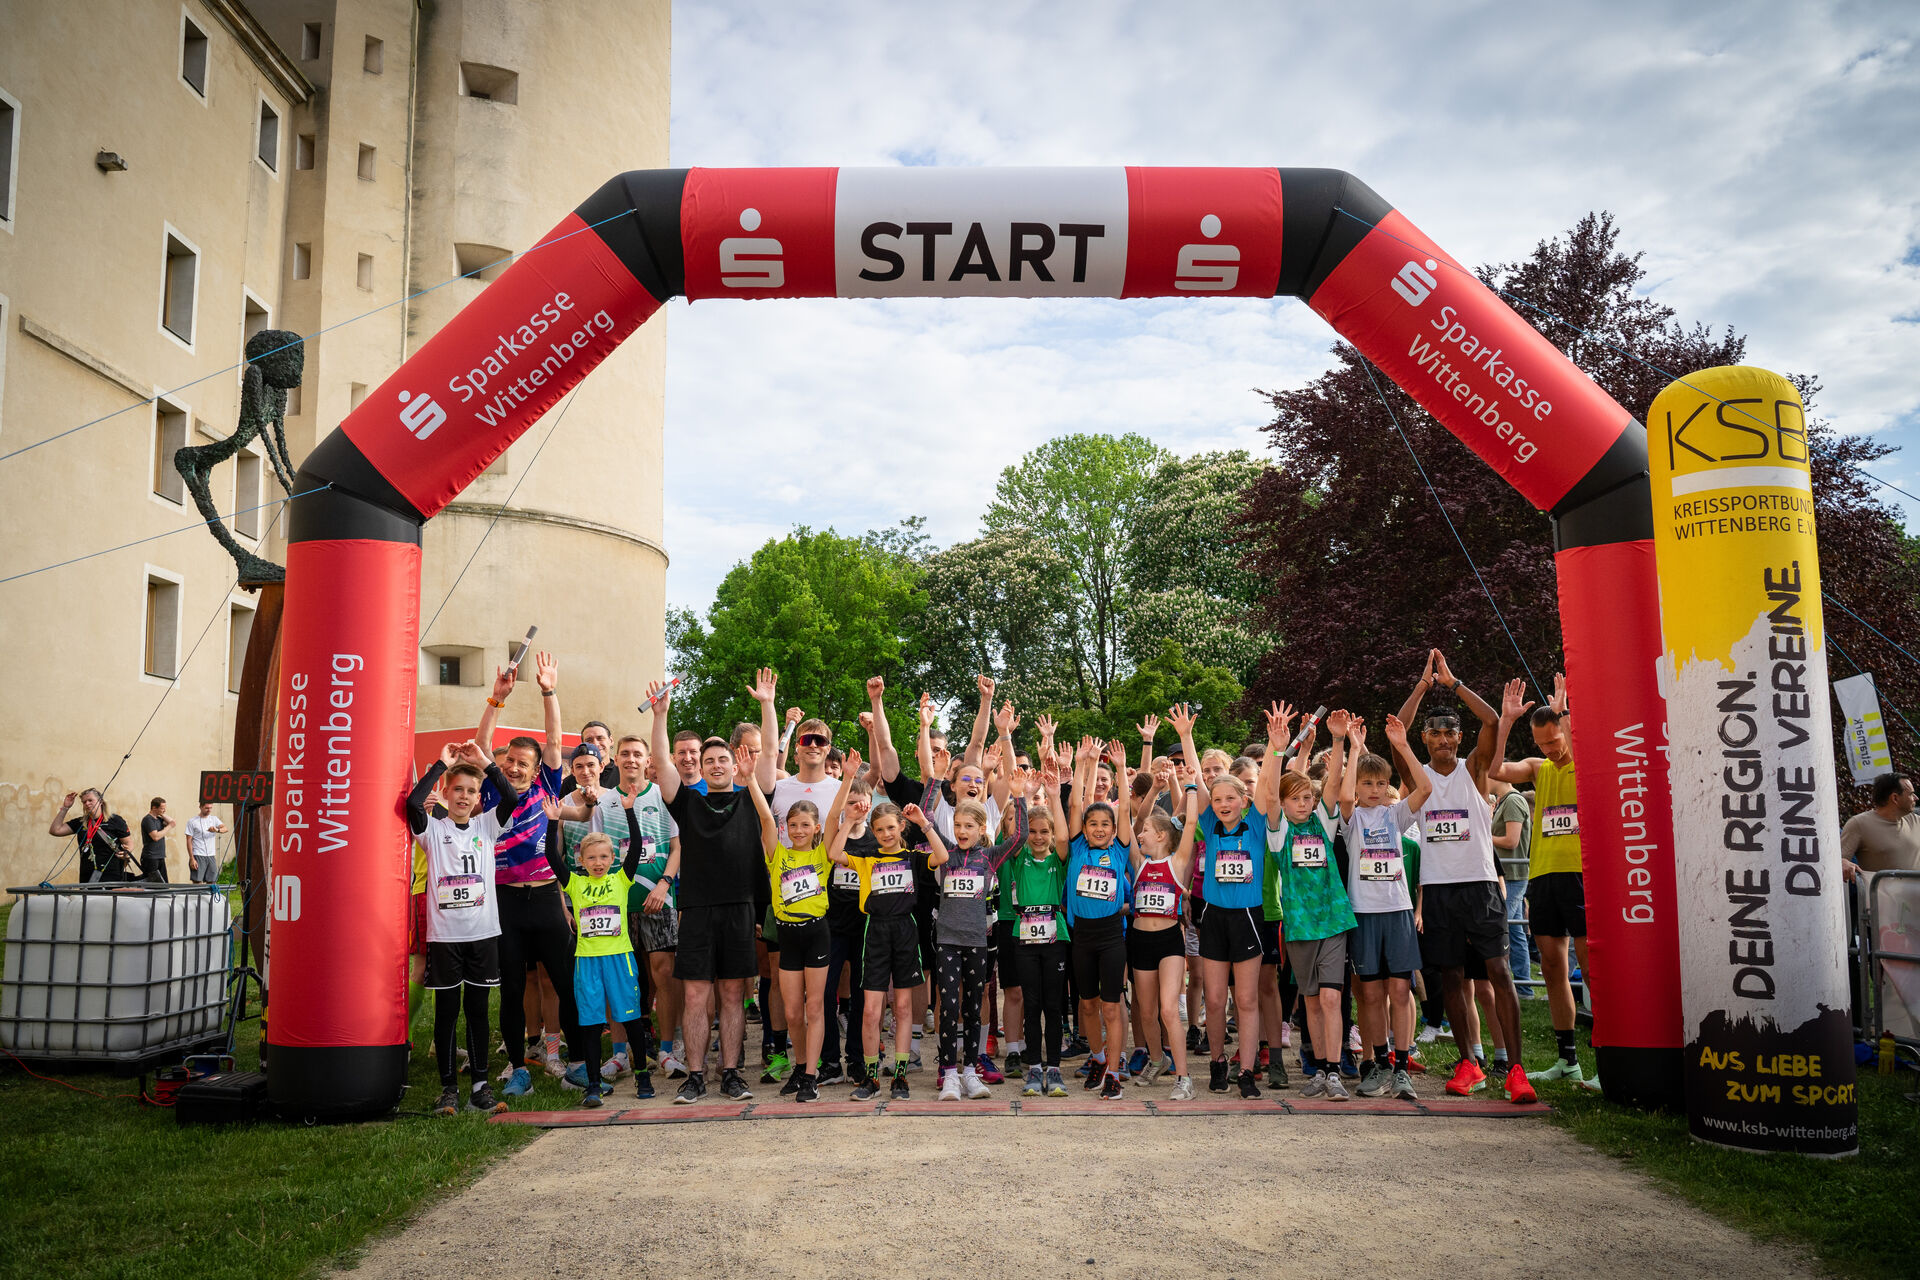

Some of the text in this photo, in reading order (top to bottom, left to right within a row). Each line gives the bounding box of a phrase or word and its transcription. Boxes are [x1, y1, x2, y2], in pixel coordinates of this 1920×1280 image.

[858, 222, 1105, 282] START
[448, 292, 575, 403] Sparkasse
[474, 309, 615, 427] Wittenberg
[1430, 305, 1552, 421] Sparkasse
[1407, 333, 1538, 464] Wittenberg
[1666, 398, 1807, 471] KSB
[1673, 494, 1813, 520] KREISSPORTBUND
[1675, 516, 1791, 541] WITTENBERG
[1764, 560, 1821, 896] DEINE VEREINE.
[280, 672, 309, 853] Sparkasse
[317, 653, 363, 854] Wittenberg
[1435, 821, 1457, 834] 431
[1550, 816, 1571, 829] 140
[1614, 722, 1658, 923] Wittenberg
[1717, 671, 1775, 1000] DEINE REGION.
[461, 854, 476, 873] 11
[1304, 848, 1319, 859] 54
[1221, 863, 1244, 876] 133
[1374, 861, 1389, 873] 81
[793, 879, 809, 893] 24
[880, 874, 903, 886] 107
[952, 879, 974, 891] 153
[1086, 878, 1109, 892] 113
[453, 888, 469, 900] 95
[1143, 894, 1165, 907] 155
[589, 917, 612, 930] 337
[1030, 925, 1046, 937] 94
[1699, 1046, 1822, 1078] AUS LIEBE
[1726, 1080, 1857, 1106] ZUM SPORT.
[1703, 1116, 1857, 1141] www.ksb-wittenberg.de
